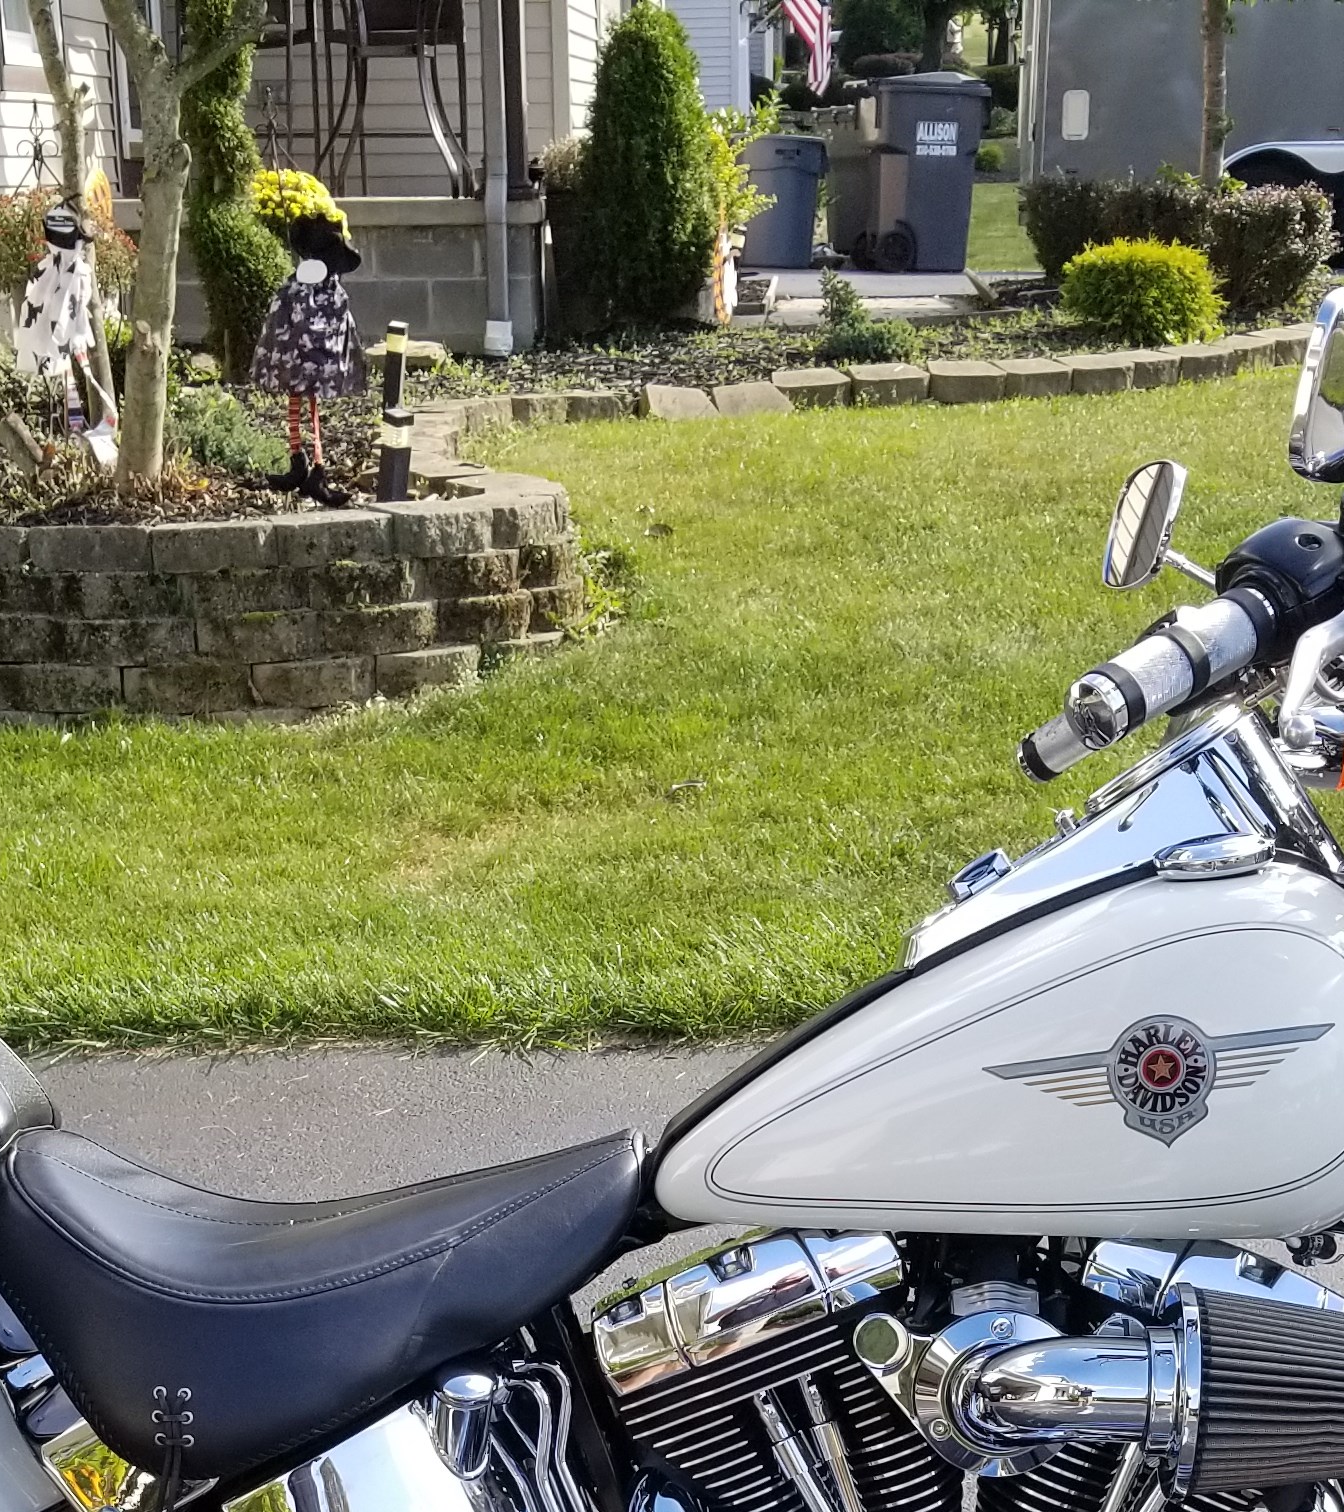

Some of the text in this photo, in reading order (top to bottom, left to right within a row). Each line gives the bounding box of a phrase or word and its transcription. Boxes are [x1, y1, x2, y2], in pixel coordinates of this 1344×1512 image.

[917, 121, 958, 142] ALLISON
[1118, 1024, 1207, 1113] HARLEY DAVIDSON
[1138, 1109, 1196, 1134] USA
